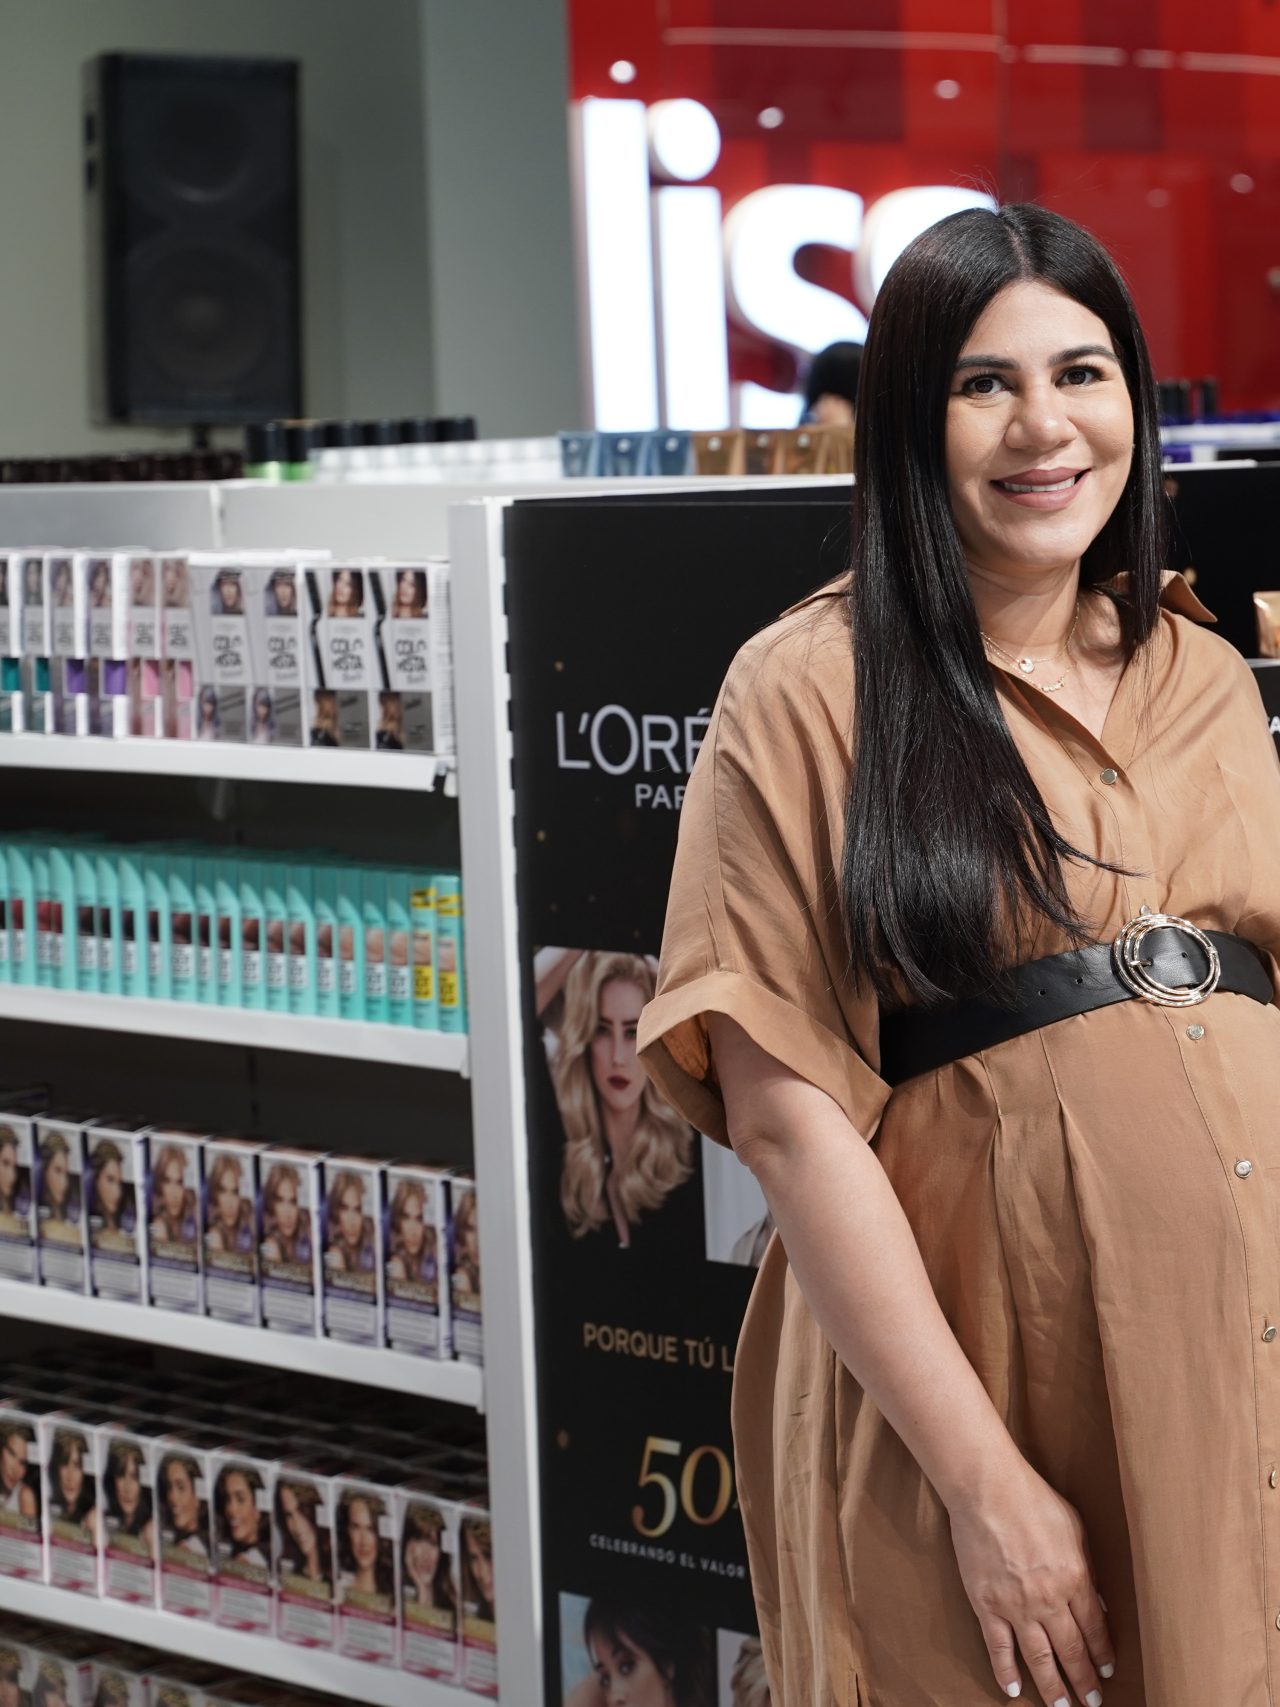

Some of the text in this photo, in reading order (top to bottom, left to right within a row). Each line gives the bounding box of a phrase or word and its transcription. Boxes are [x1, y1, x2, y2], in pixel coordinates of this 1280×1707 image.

[555, 704, 712, 775] L'ORÉ
[583, 1322, 735, 1373] PORQUE TÚ L
[631, 1435, 733, 1538] 50
[589, 1533, 746, 1579] CELEBRANDO EL VALOR
